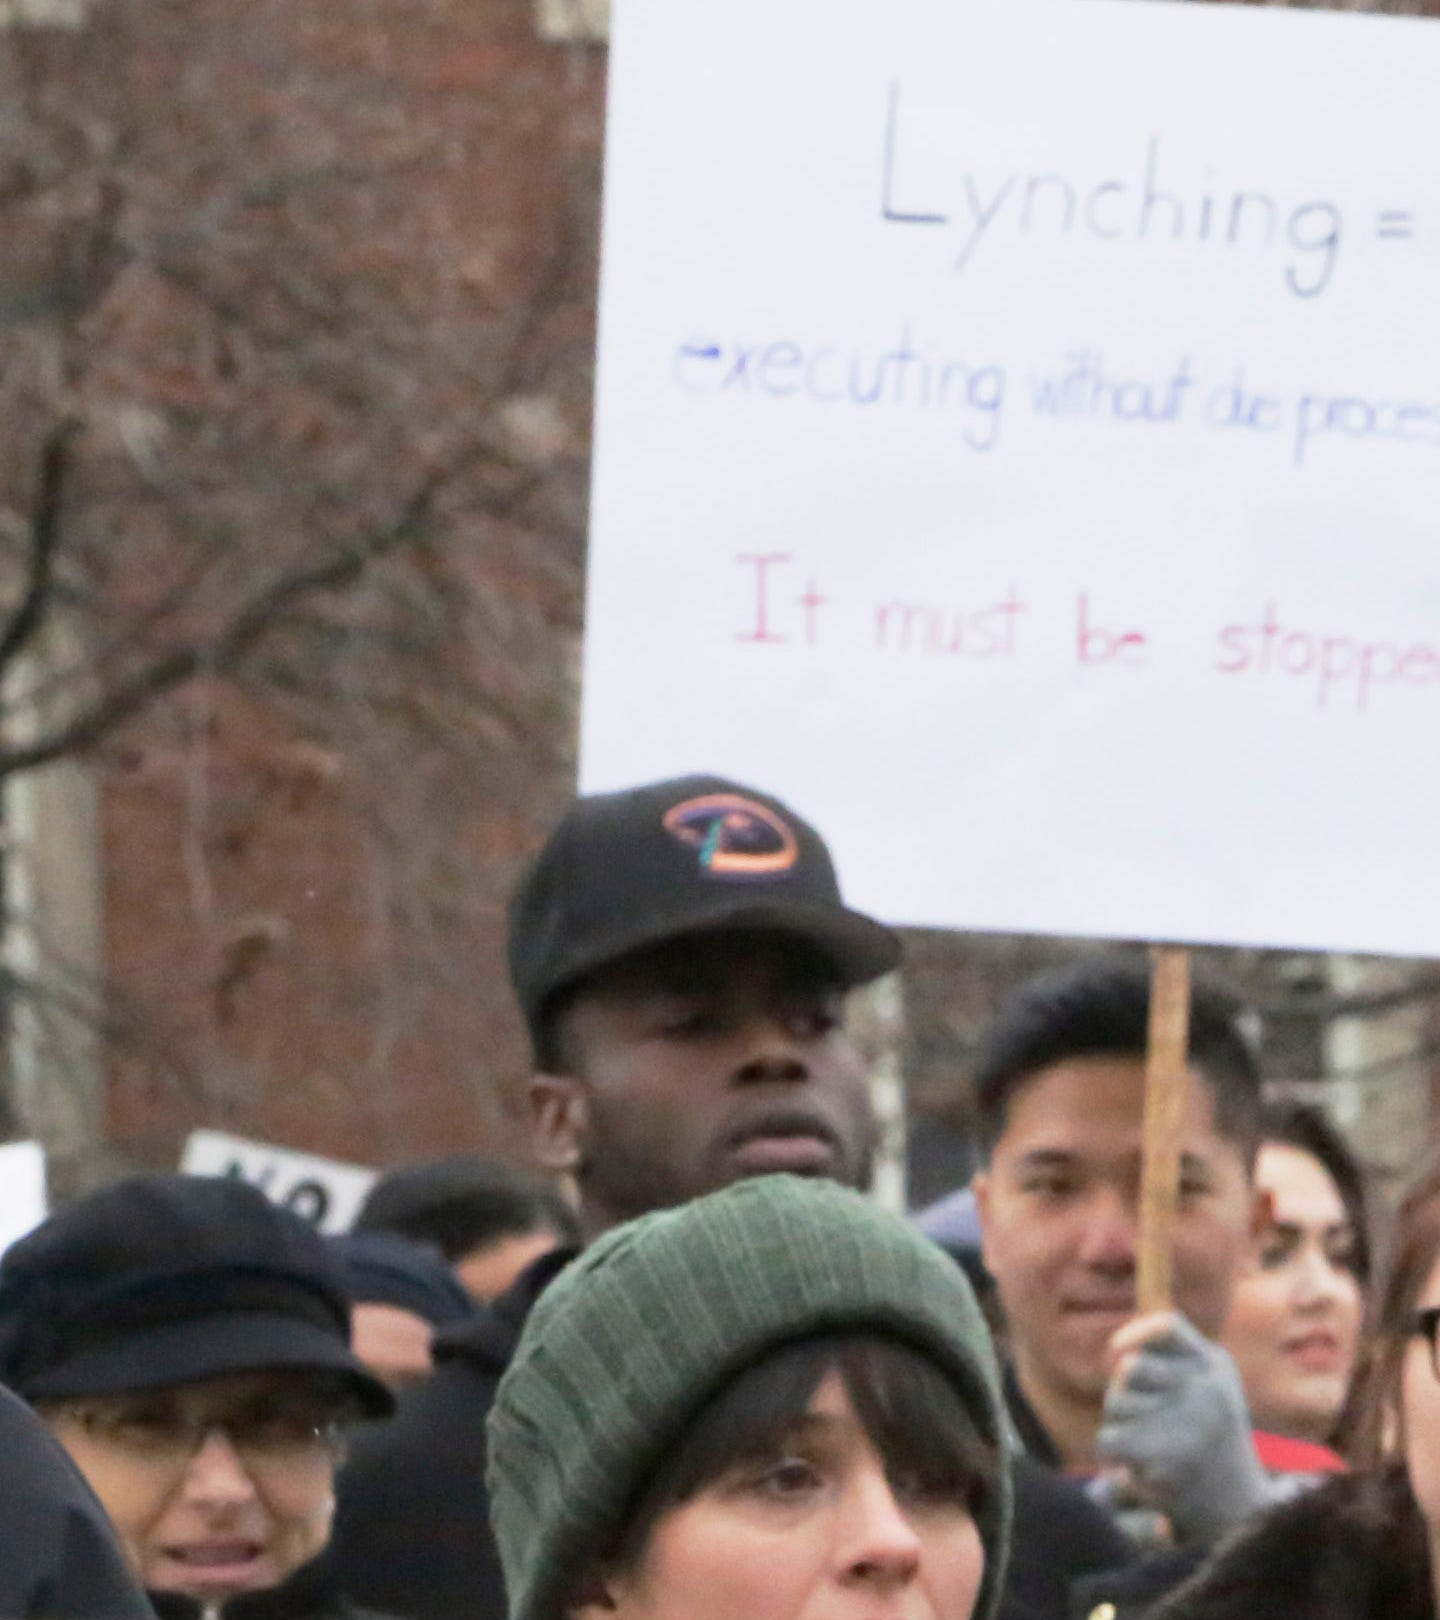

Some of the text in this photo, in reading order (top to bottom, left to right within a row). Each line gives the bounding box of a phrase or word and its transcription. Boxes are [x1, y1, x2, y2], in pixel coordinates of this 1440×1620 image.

[879, 77, 1344, 299] Lynching
[672, 322, 1008, 454] executing
[1030, 345, 1194, 424] without
[734, 549, 830, 648] It
[874, 576, 1028, 656] must
[1076, 589, 1150, 667] be
